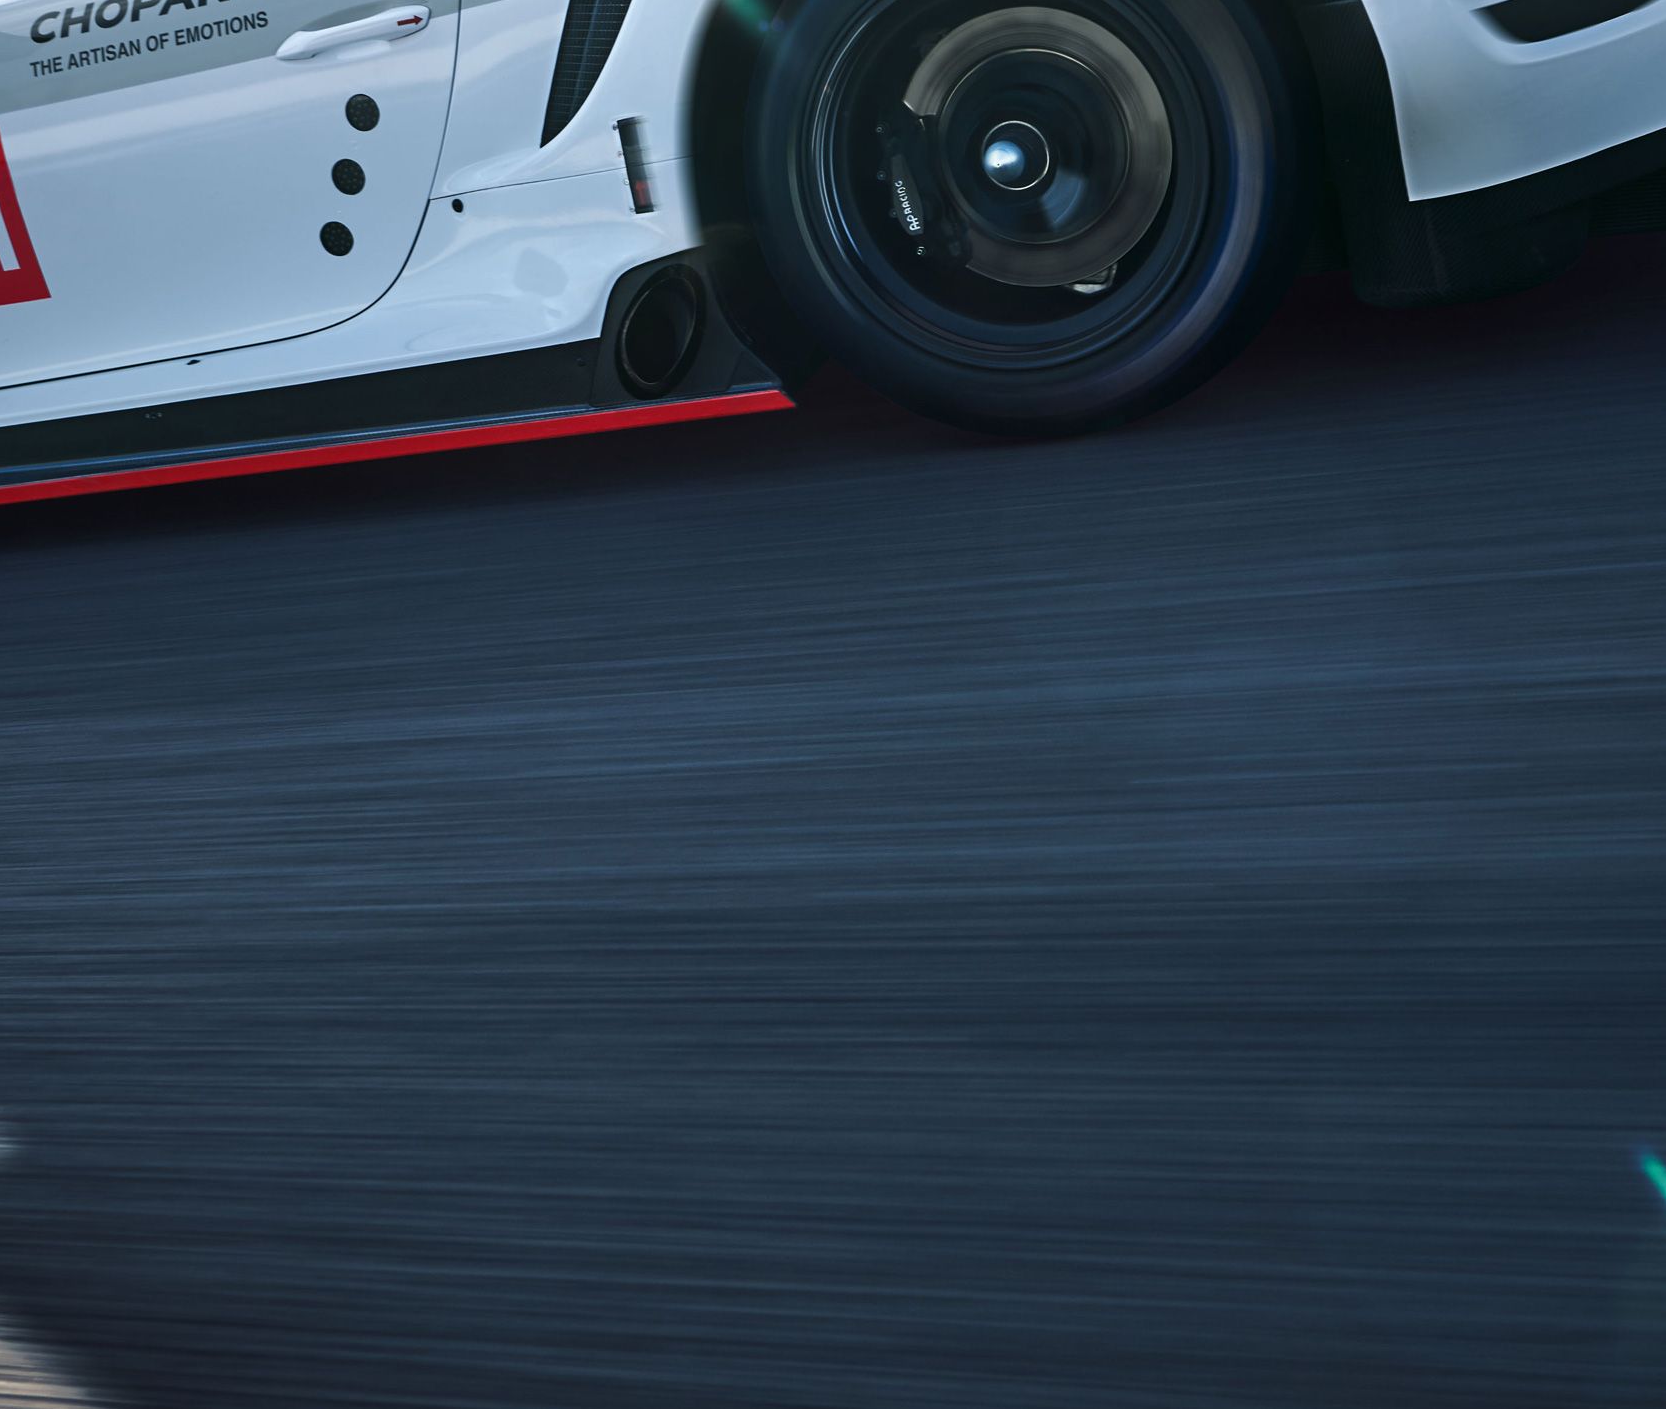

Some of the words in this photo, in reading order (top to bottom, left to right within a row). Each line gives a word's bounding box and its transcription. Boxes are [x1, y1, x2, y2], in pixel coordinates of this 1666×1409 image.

[29, 56, 64, 78] THE
[67, 38, 142, 70] ARTISAN
[146, 32, 170, 52] OF
[174, 11, 270, 46] EMOTIONS
